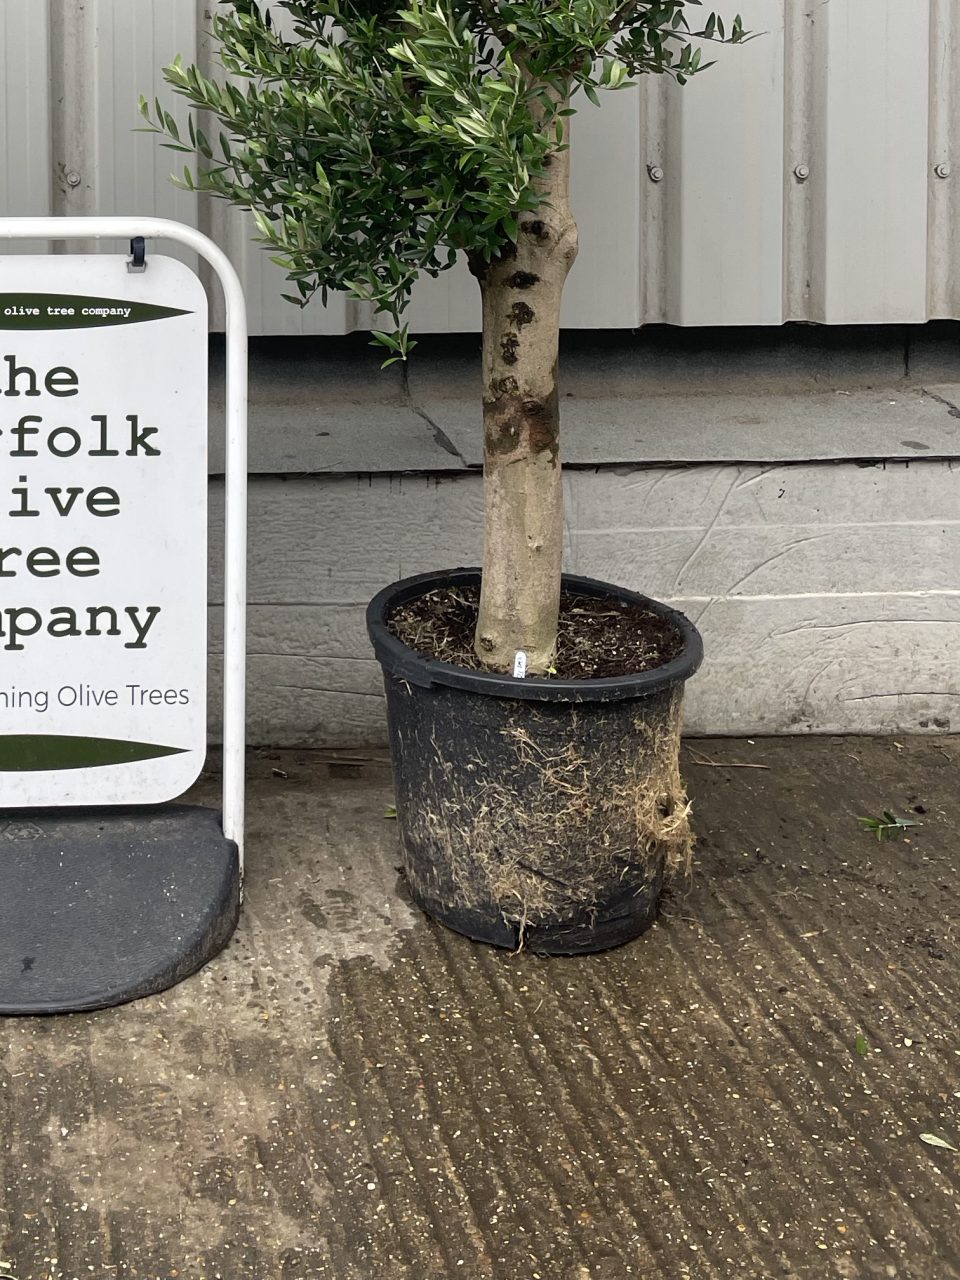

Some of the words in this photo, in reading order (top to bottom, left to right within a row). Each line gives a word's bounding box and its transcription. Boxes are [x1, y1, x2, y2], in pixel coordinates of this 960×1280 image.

[4, 306, 40, 316] olive
[47, 306, 75, 315] tree
[81, 307, 132, 317] company
[57, 683, 118, 707] Olive
[125, 684, 190, 706] Trees
